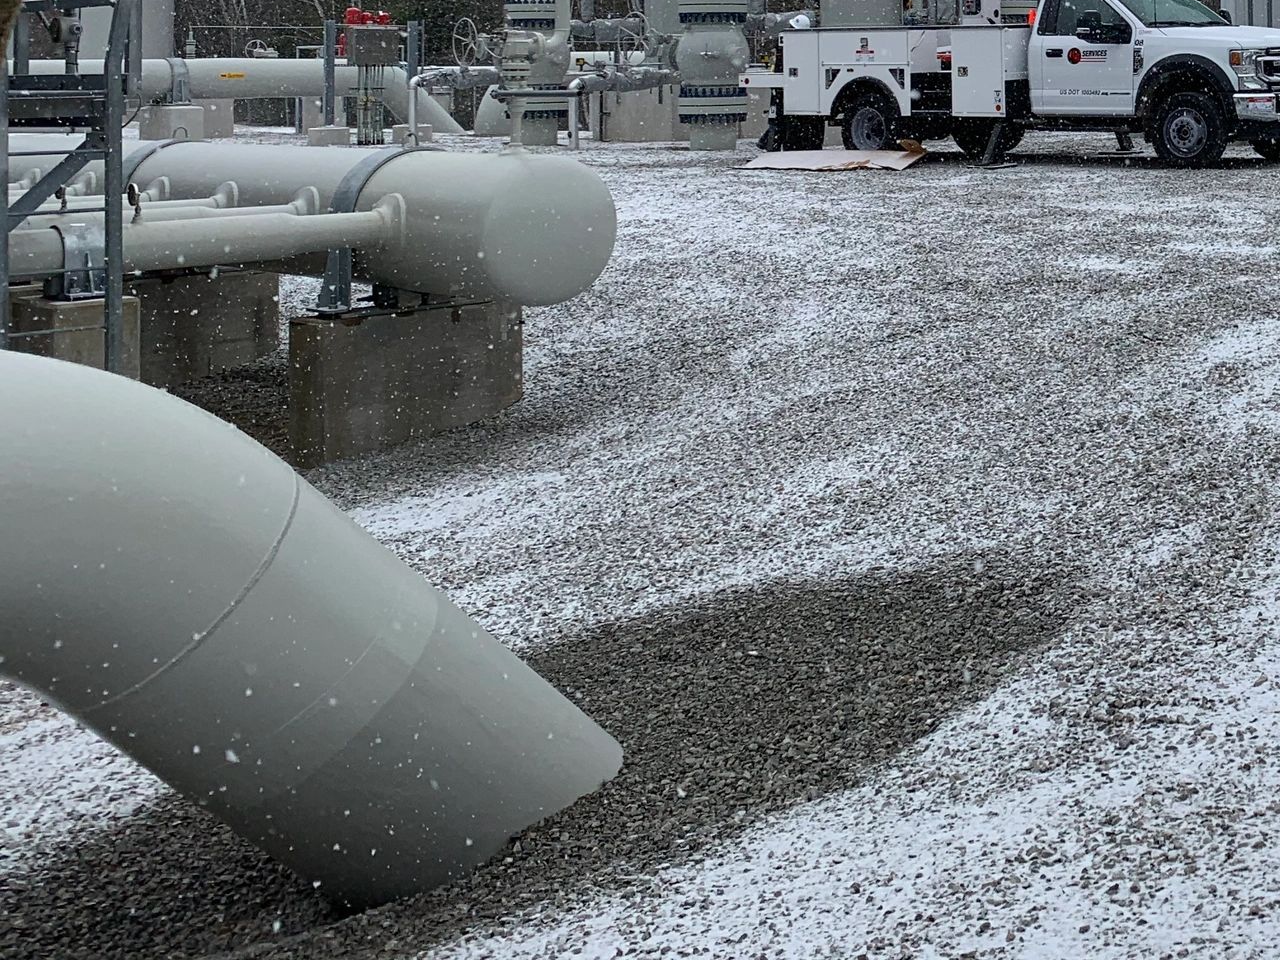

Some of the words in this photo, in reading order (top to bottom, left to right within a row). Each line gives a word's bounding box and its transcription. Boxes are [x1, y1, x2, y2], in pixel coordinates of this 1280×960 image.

[1082, 49, 1108, 57] SERVICES
[1060, 88, 1068, 96] US
[1068, 88, 1080, 96] DOT
